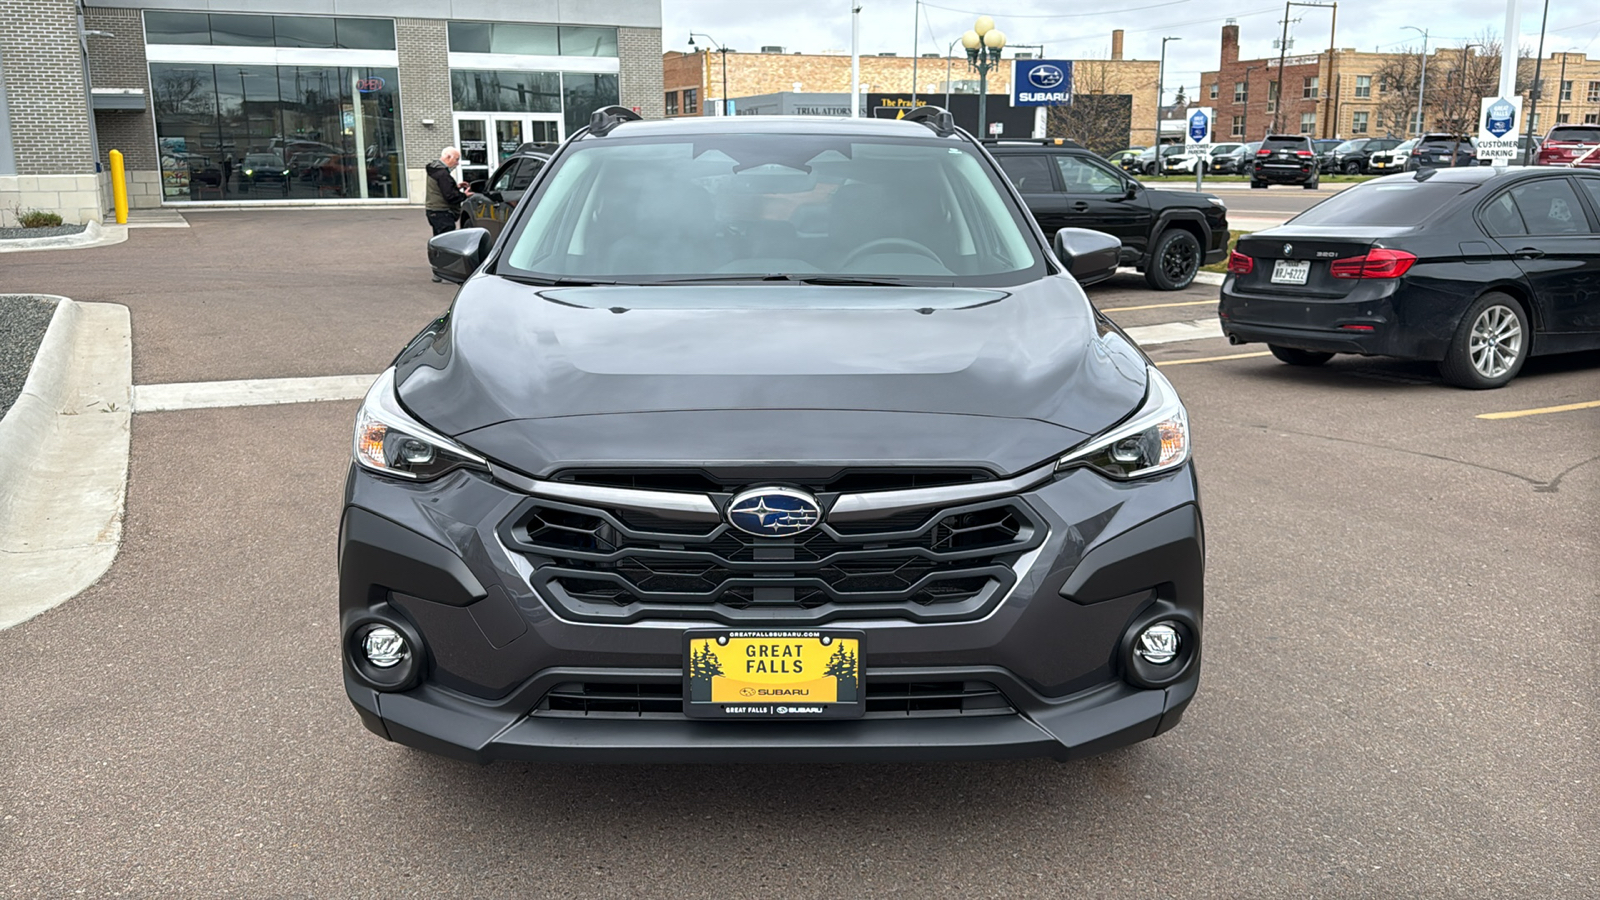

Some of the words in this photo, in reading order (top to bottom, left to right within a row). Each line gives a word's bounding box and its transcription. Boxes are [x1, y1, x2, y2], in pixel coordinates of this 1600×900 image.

[1019, 92, 1069, 102] SUBARU
[881, 98, 896, 107] The
[897, 98, 927, 107] Pracice
[797, 107, 821, 115] TRIAL
[822, 107, 868, 115] ATTORNYS
[1478, 140, 1518, 148] CUSTOMER
[1480, 149, 1513, 157] PARKING
[746, 645, 803, 657] GREAT
[746, 660, 803, 673] FALLS
[758, 688, 810, 696] SUBARU
[788, 706, 823, 714] SUBARU
